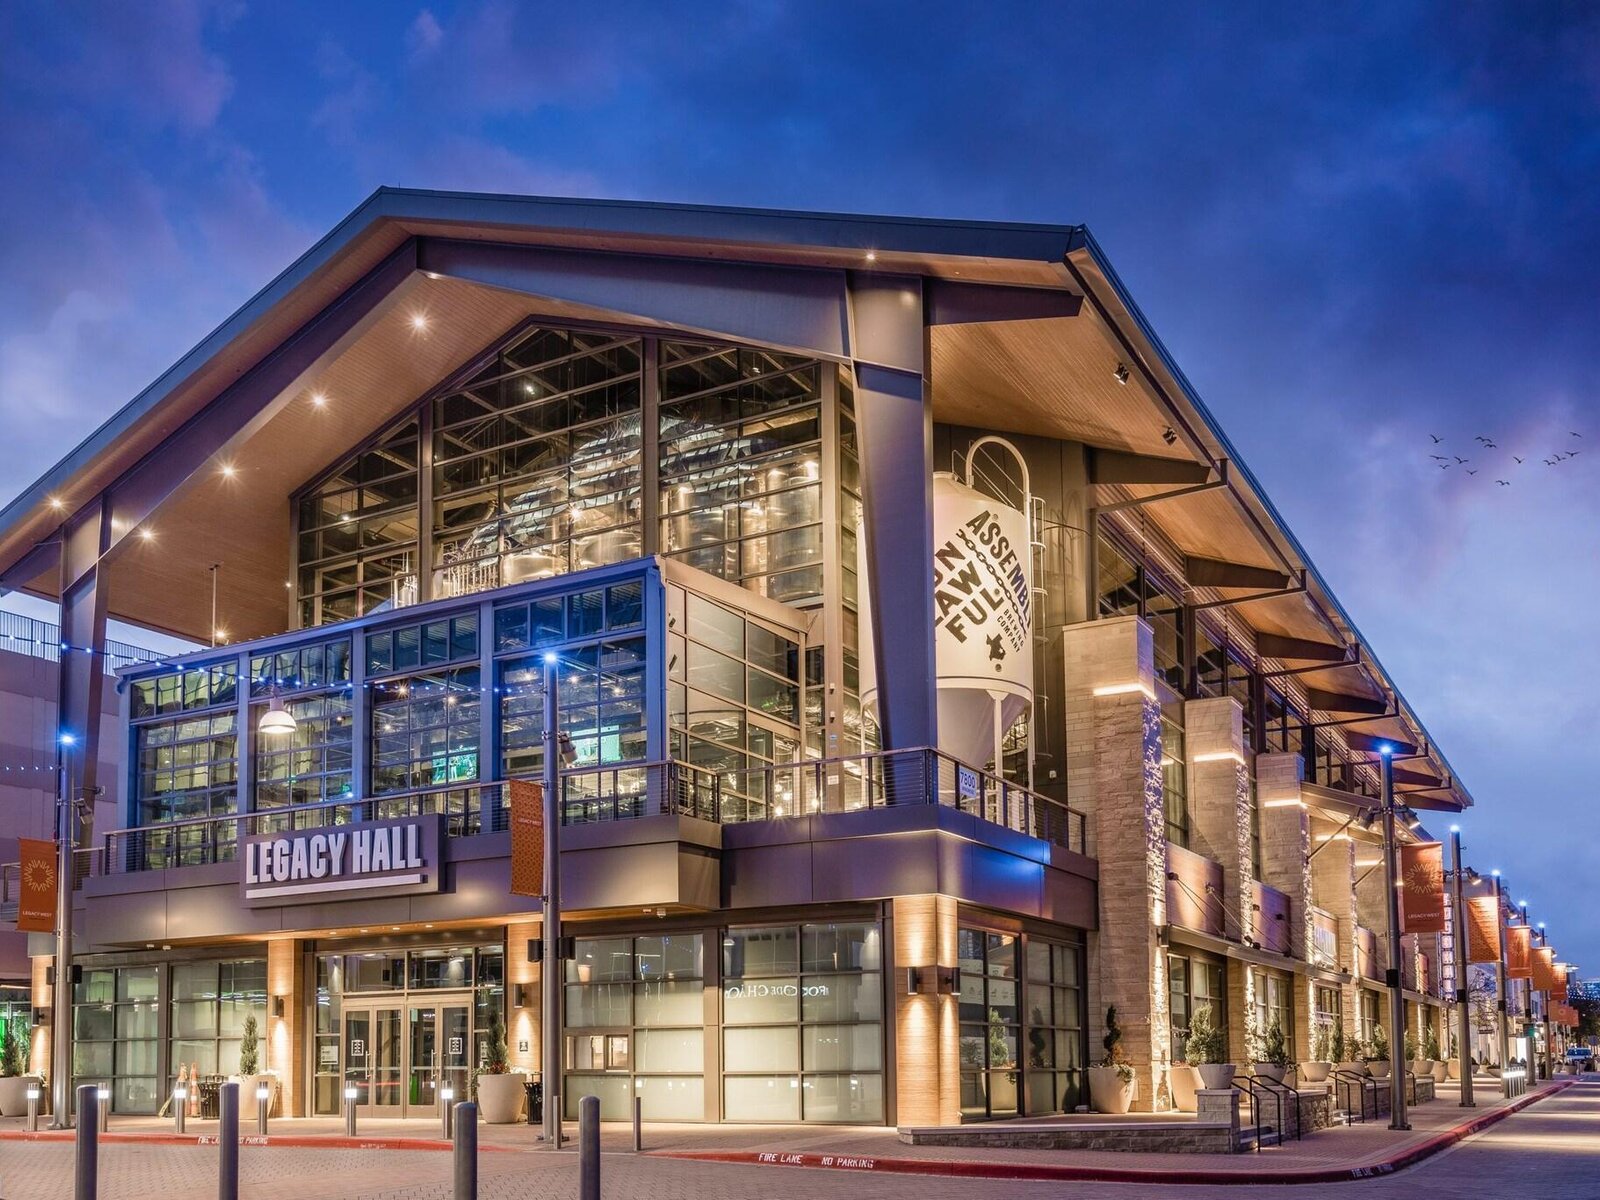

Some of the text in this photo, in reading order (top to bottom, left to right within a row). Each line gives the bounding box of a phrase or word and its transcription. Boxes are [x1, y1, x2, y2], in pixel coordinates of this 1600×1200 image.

[945, 588, 1004, 643] FUL
[997, 615, 1020, 652] COMPANY
[1003, 608, 1024, 647] BREWING
[960, 771, 976, 789] 7800
[246, 824, 423, 884] LEGACY HALL
[758, 1152, 874, 1169] FIRE LANE NO PARKING
